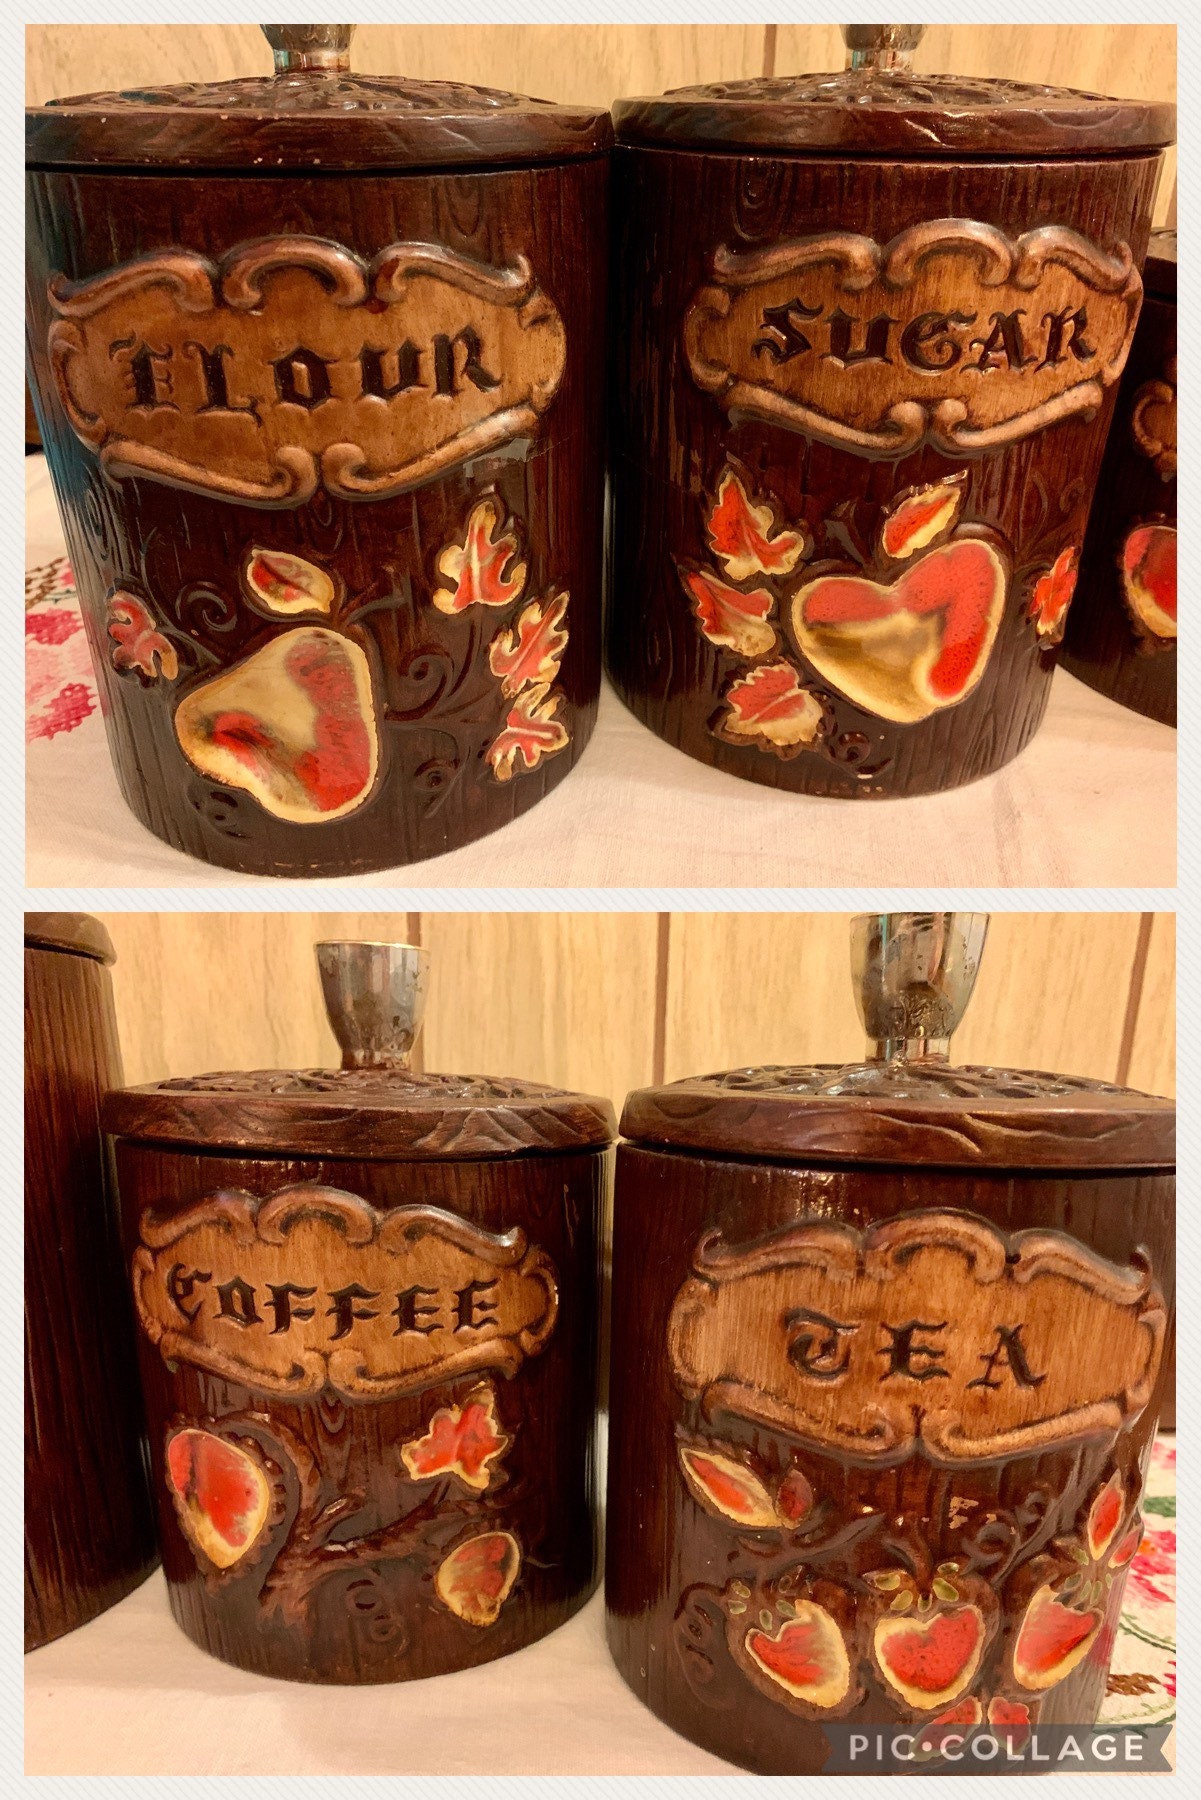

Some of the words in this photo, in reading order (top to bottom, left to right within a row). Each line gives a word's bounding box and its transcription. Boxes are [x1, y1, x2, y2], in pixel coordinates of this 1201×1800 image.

[109, 325, 501, 428] FLOUR
[751, 299, 1097, 376] SUGAR
[166, 1262, 501, 1340] COFFEE
[785, 1308, 1047, 1390] TEA
